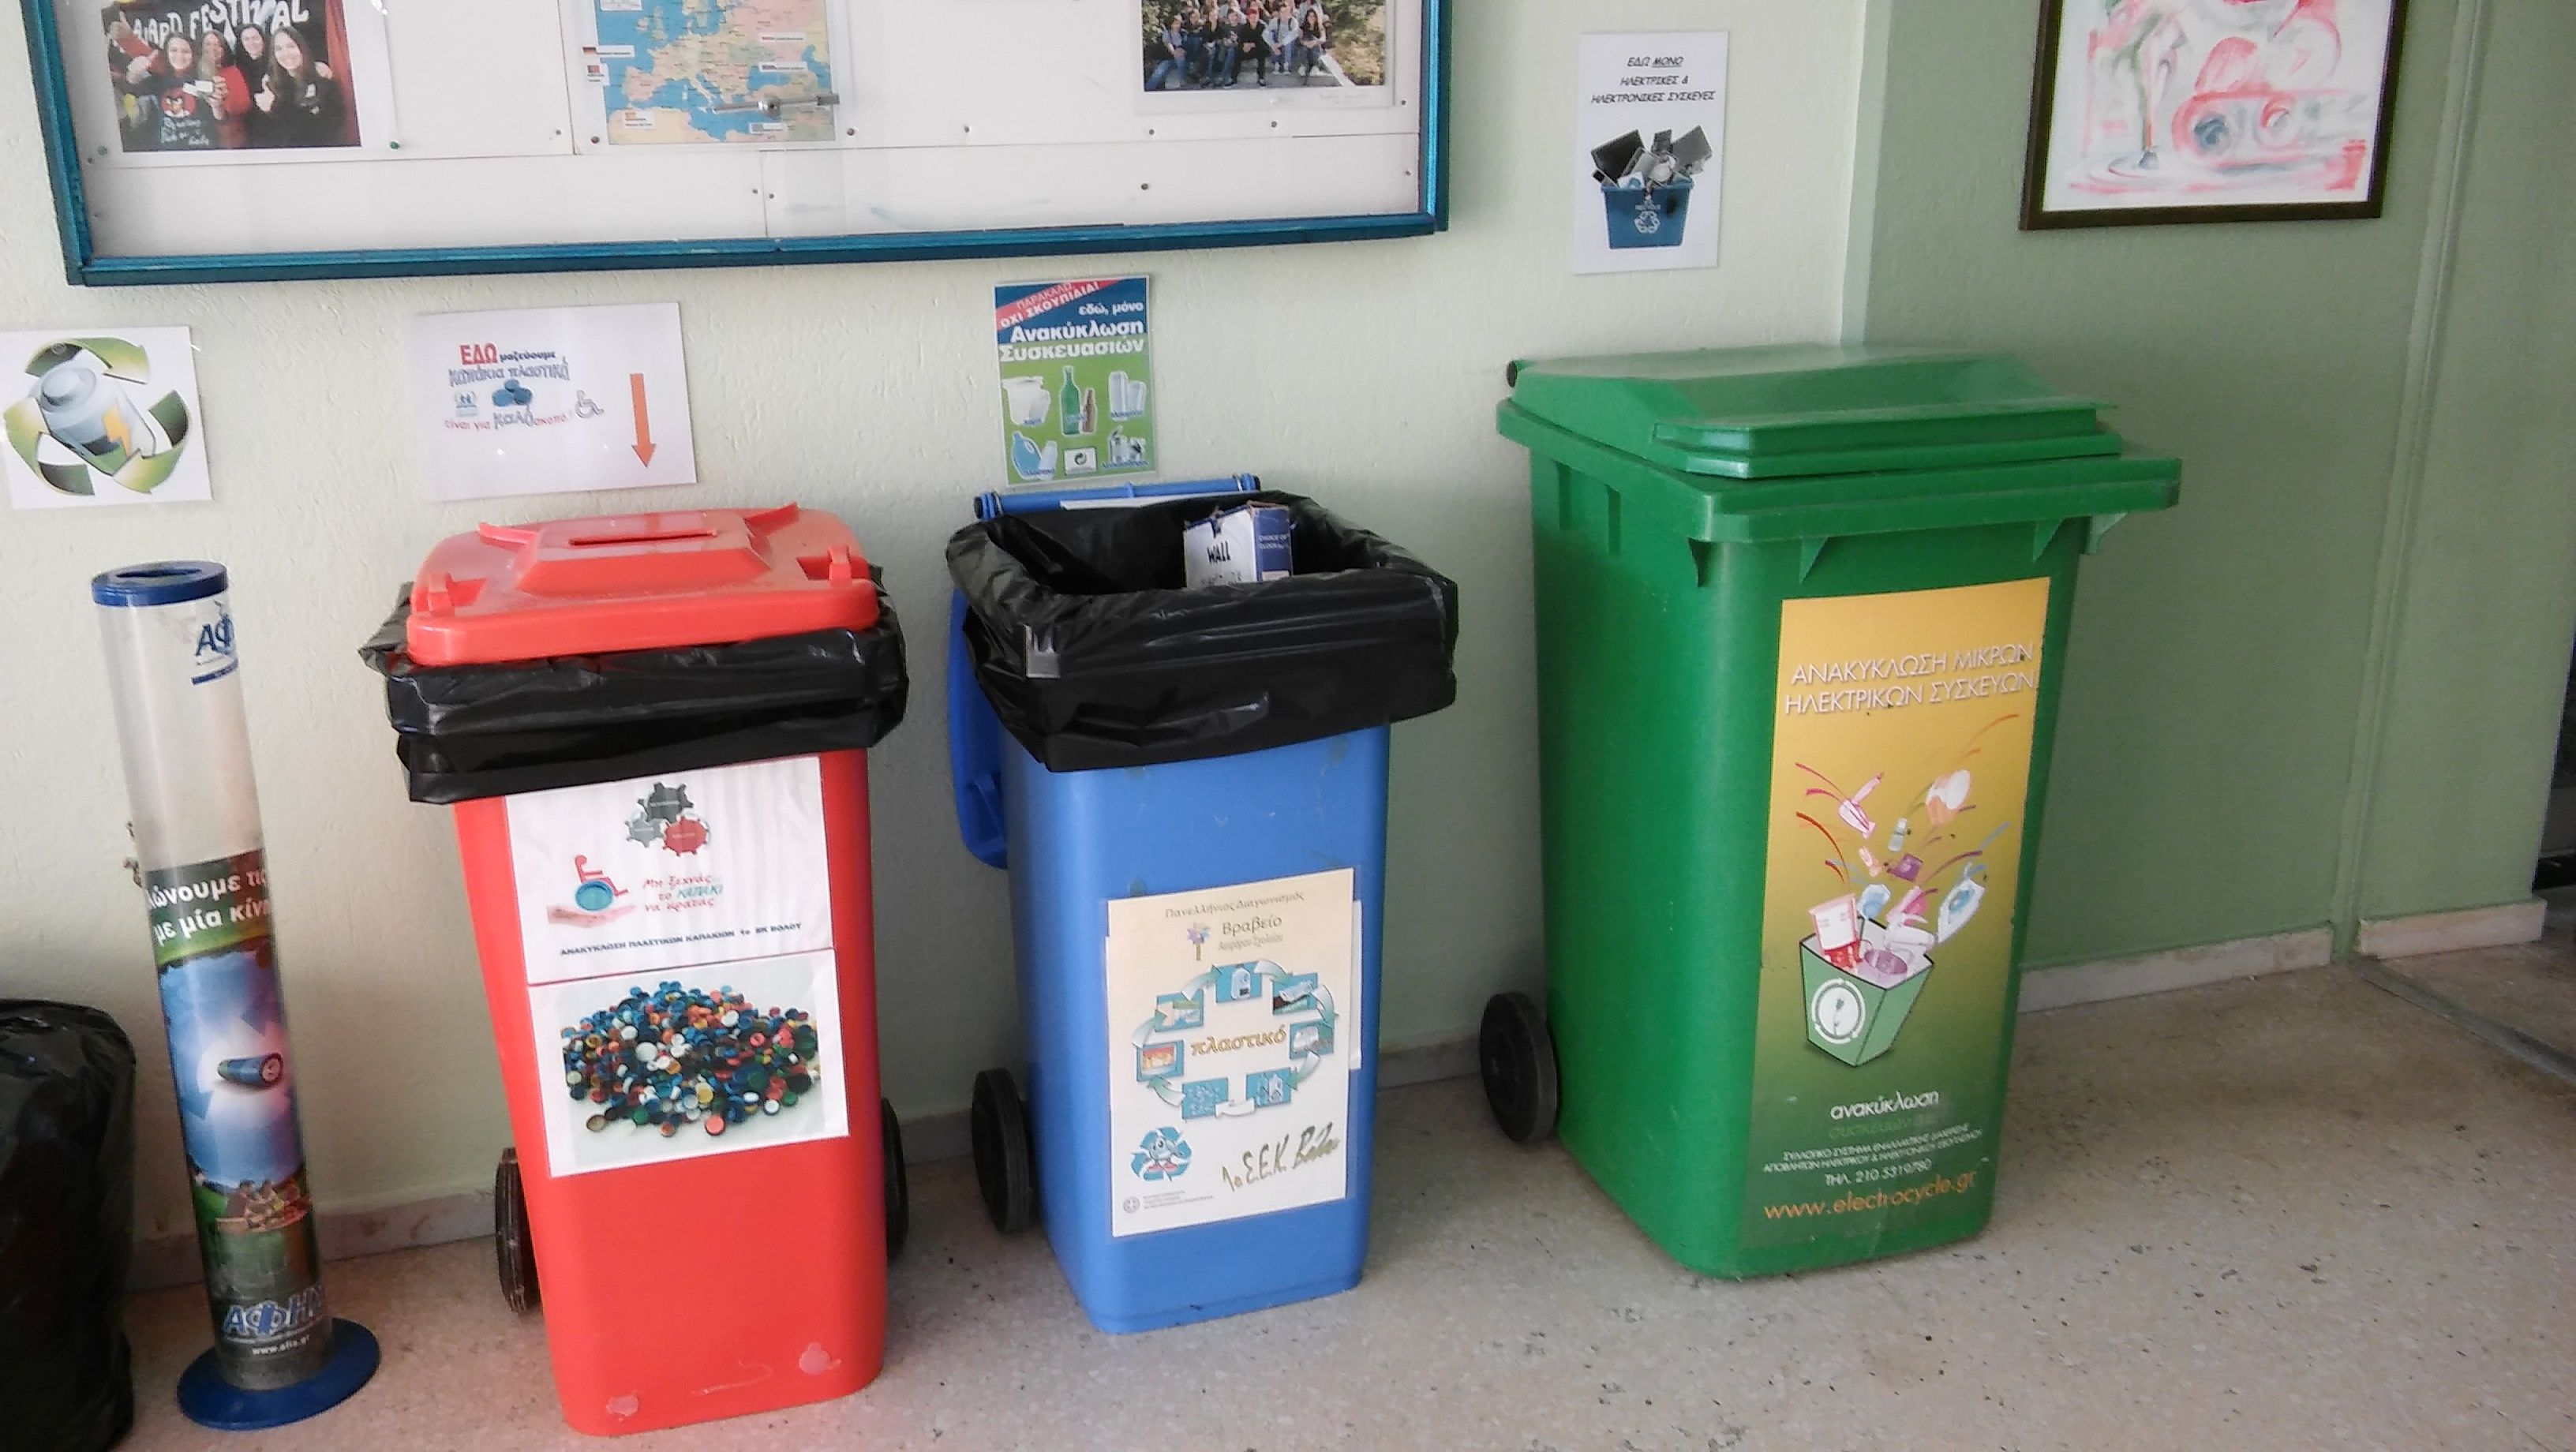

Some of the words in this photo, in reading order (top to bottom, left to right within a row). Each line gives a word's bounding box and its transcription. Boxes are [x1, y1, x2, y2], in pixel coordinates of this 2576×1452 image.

[1627, 57, 1649, 66] ΕΔΩ
[1653, 56, 1683, 67] ΜΟΝΟ
[1620, 76, 1679, 86] ΗΛΕΚΤΡΙΚΕΣ
[1591, 92, 1664, 103] ΗΛΕΚΤΡΟΝΙΚΕΣ
[1668, 91, 1715, 101] ΣΥΣΚΕΥΕΣ
[1000, 312, 1023, 329] ΟΧΙ
[1078, 302, 1109, 316] εδώ,
[1112, 301, 1144, 316] μόνο
[1010, 320, 1143, 343] Ανακύκλωση
[460, 342, 499, 365] ΕΔΩ
[500, 351, 556, 363] μαζεύουμε
[999, 335, 1144, 362] Συσκευασιών
[507, 356, 570, 380] πλαστικά
[1792, 652, 1947, 686] ΑΝΑΚΥΚΛΩΣΗ
[1953, 643, 2034, 672] ΜΙΚΡΩΝ
[1785, 685, 1924, 714] ΗΛΕΚΤΡΙΚΩΝ
[1930, 670, 2035, 704] ΣΥΣΚΕΥΩΝ
[154, 921, 177, 947] με
[179, 908, 223, 939] μία
[1222, 913, 1282, 937] Βραβείο
[1190, 1024, 1287, 1056] πλαστικό
[1830, 1090, 1940, 1120] ανακύκλωση
[1764, 1171, 1976, 1219] www.electrocycle.gr
